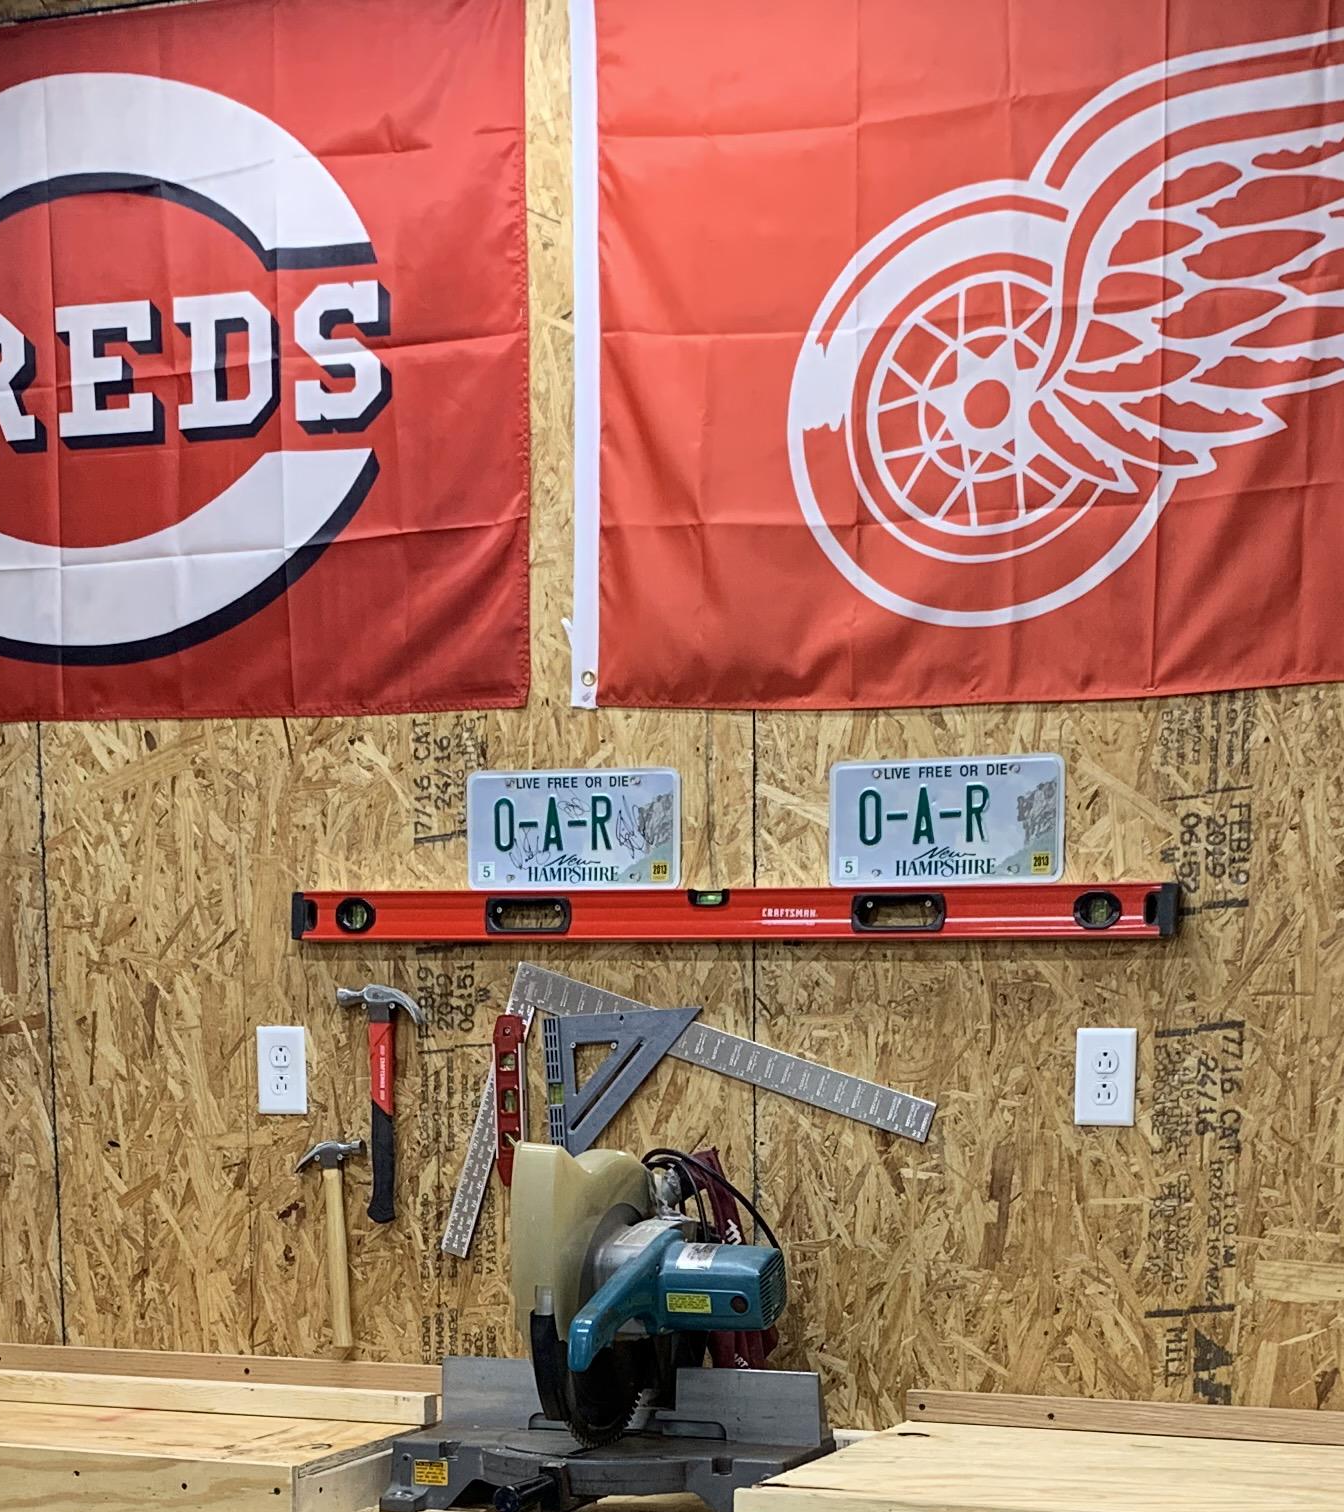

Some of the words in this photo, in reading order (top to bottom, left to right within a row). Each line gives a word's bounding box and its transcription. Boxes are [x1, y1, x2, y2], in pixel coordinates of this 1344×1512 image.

[411, 718, 431, 762] CAT
[433, 735, 452, 811] 24/16
[516, 776, 541, 790] LIVE
[547, 776, 579, 789] FREE
[585, 776, 603, 788] OR
[609, 775, 630, 788] DIE
[884, 767, 911, 780] LIVE
[919, 765, 953, 779] FREE
[960, 764, 979, 777] OR
[987, 763, 1008, 776] DIE
[412, 774, 433, 836] 7/16
[545, 853, 601, 867] New
[913, 846, 977, 860] New
[1204, 813, 1228, 879] 2019
[1228, 802, 1252, 886] FEB19
[482, 866, 491, 878] 5
[528, 865, 620, 884] HAMPSHIRE
[844, 861, 853, 874] 5
[896, 858, 996, 878] HAMPSHIRE
[762, 907, 817, 917] CRAFTSMAN
[436, 973, 455, 1032] 2019
[455, 961, 475, 1032] 06:51
[1195, 1056, 1219, 1136] 24/16
[1218, 1109, 1242, 1154] CAT
[1166, 1326, 1188, 1388] MILL
